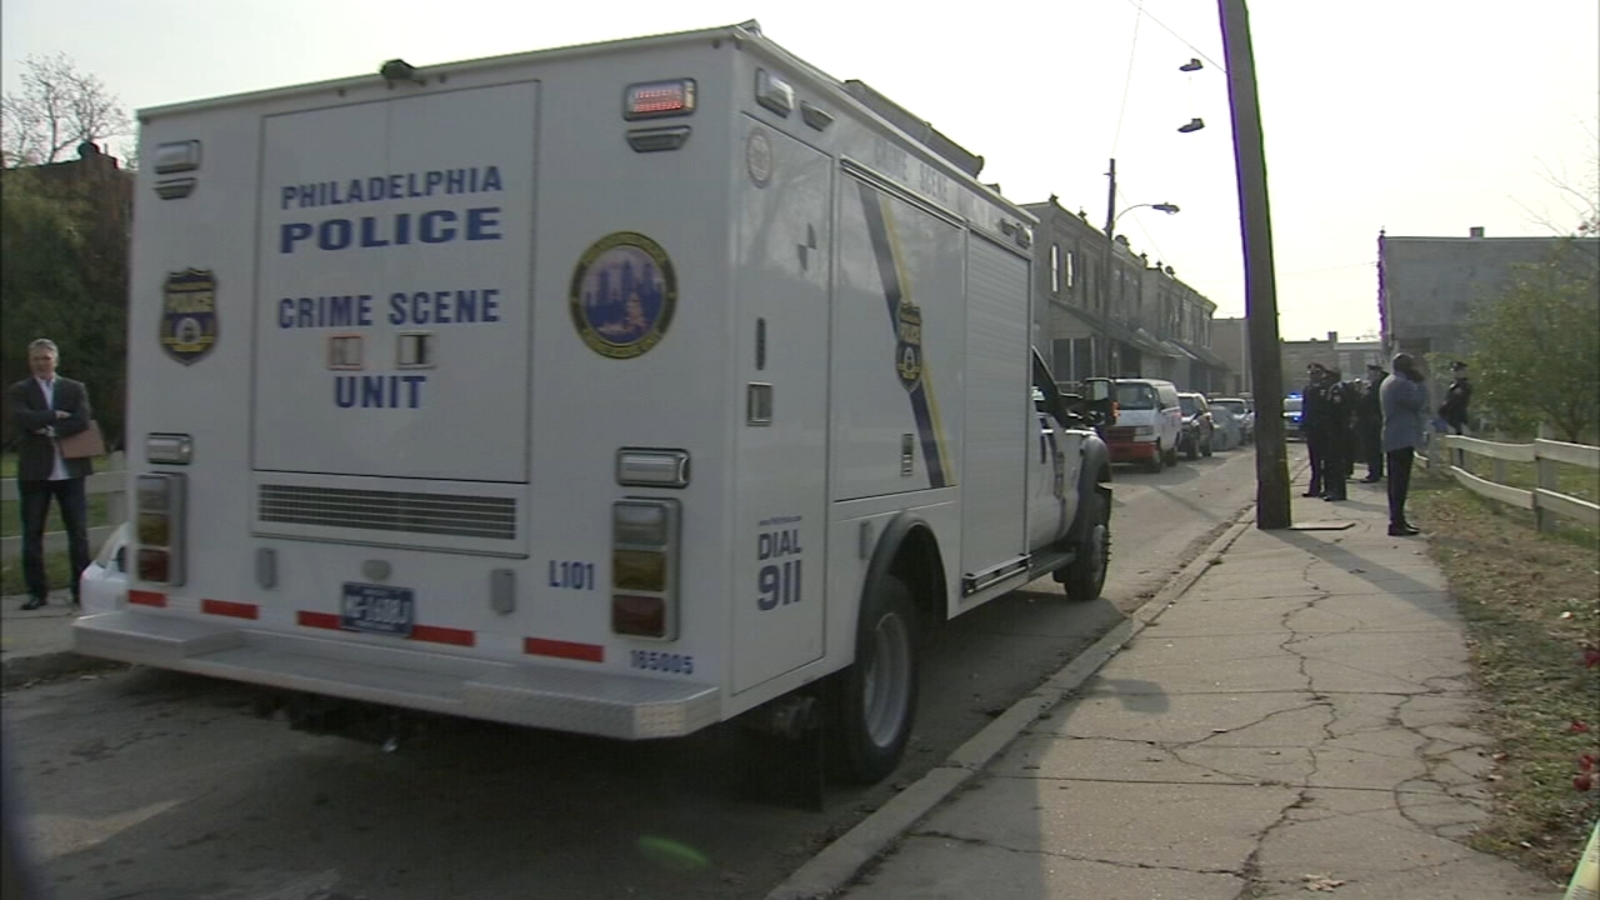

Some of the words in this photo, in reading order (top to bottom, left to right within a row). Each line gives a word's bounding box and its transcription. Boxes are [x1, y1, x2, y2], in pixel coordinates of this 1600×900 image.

[280, 165, 503, 211] PHILADELPHIA
[280, 207, 502, 254] POLICE
[278, 294, 373, 329] CRIME
[388, 289, 499, 325] SCENE
[335, 375, 427, 409] UNIT
[758, 529, 802, 560] DIAL
[549, 559, 595, 591] L101
[757, 560, 802, 611] 911
